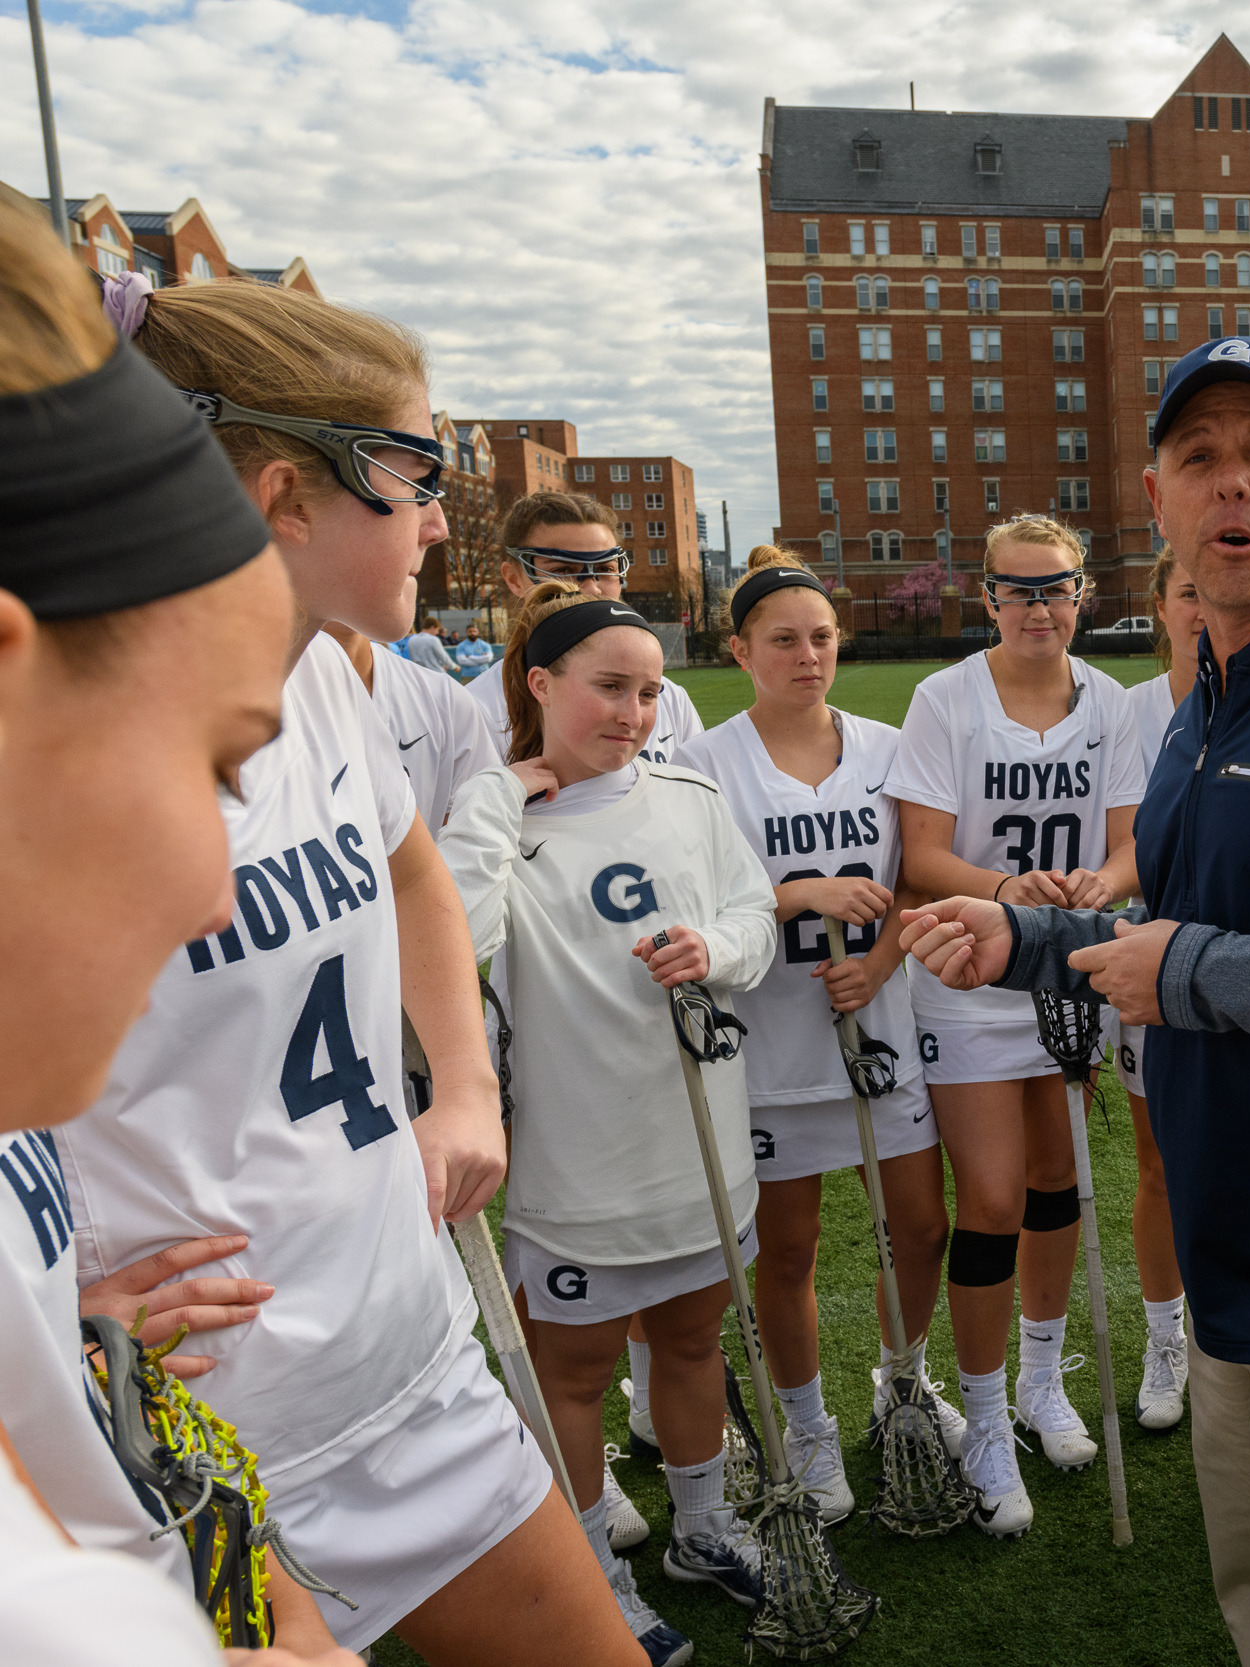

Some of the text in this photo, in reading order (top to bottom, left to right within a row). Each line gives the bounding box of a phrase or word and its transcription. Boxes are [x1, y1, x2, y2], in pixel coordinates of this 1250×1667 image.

[316, 429, 348, 445] STX
[984, 760, 1090, 800] HOYAS
[764, 807, 880, 857] HOYAS
[992, 813, 1082, 877] 30
[591, 862, 661, 924] G
[280, 953, 398, 1151] 4
[920, 1032, 940, 1064] G
[1121, 1044, 1136, 1075] G
[750, 1129, 775, 1161] G
[546, 1264, 589, 1302] G
